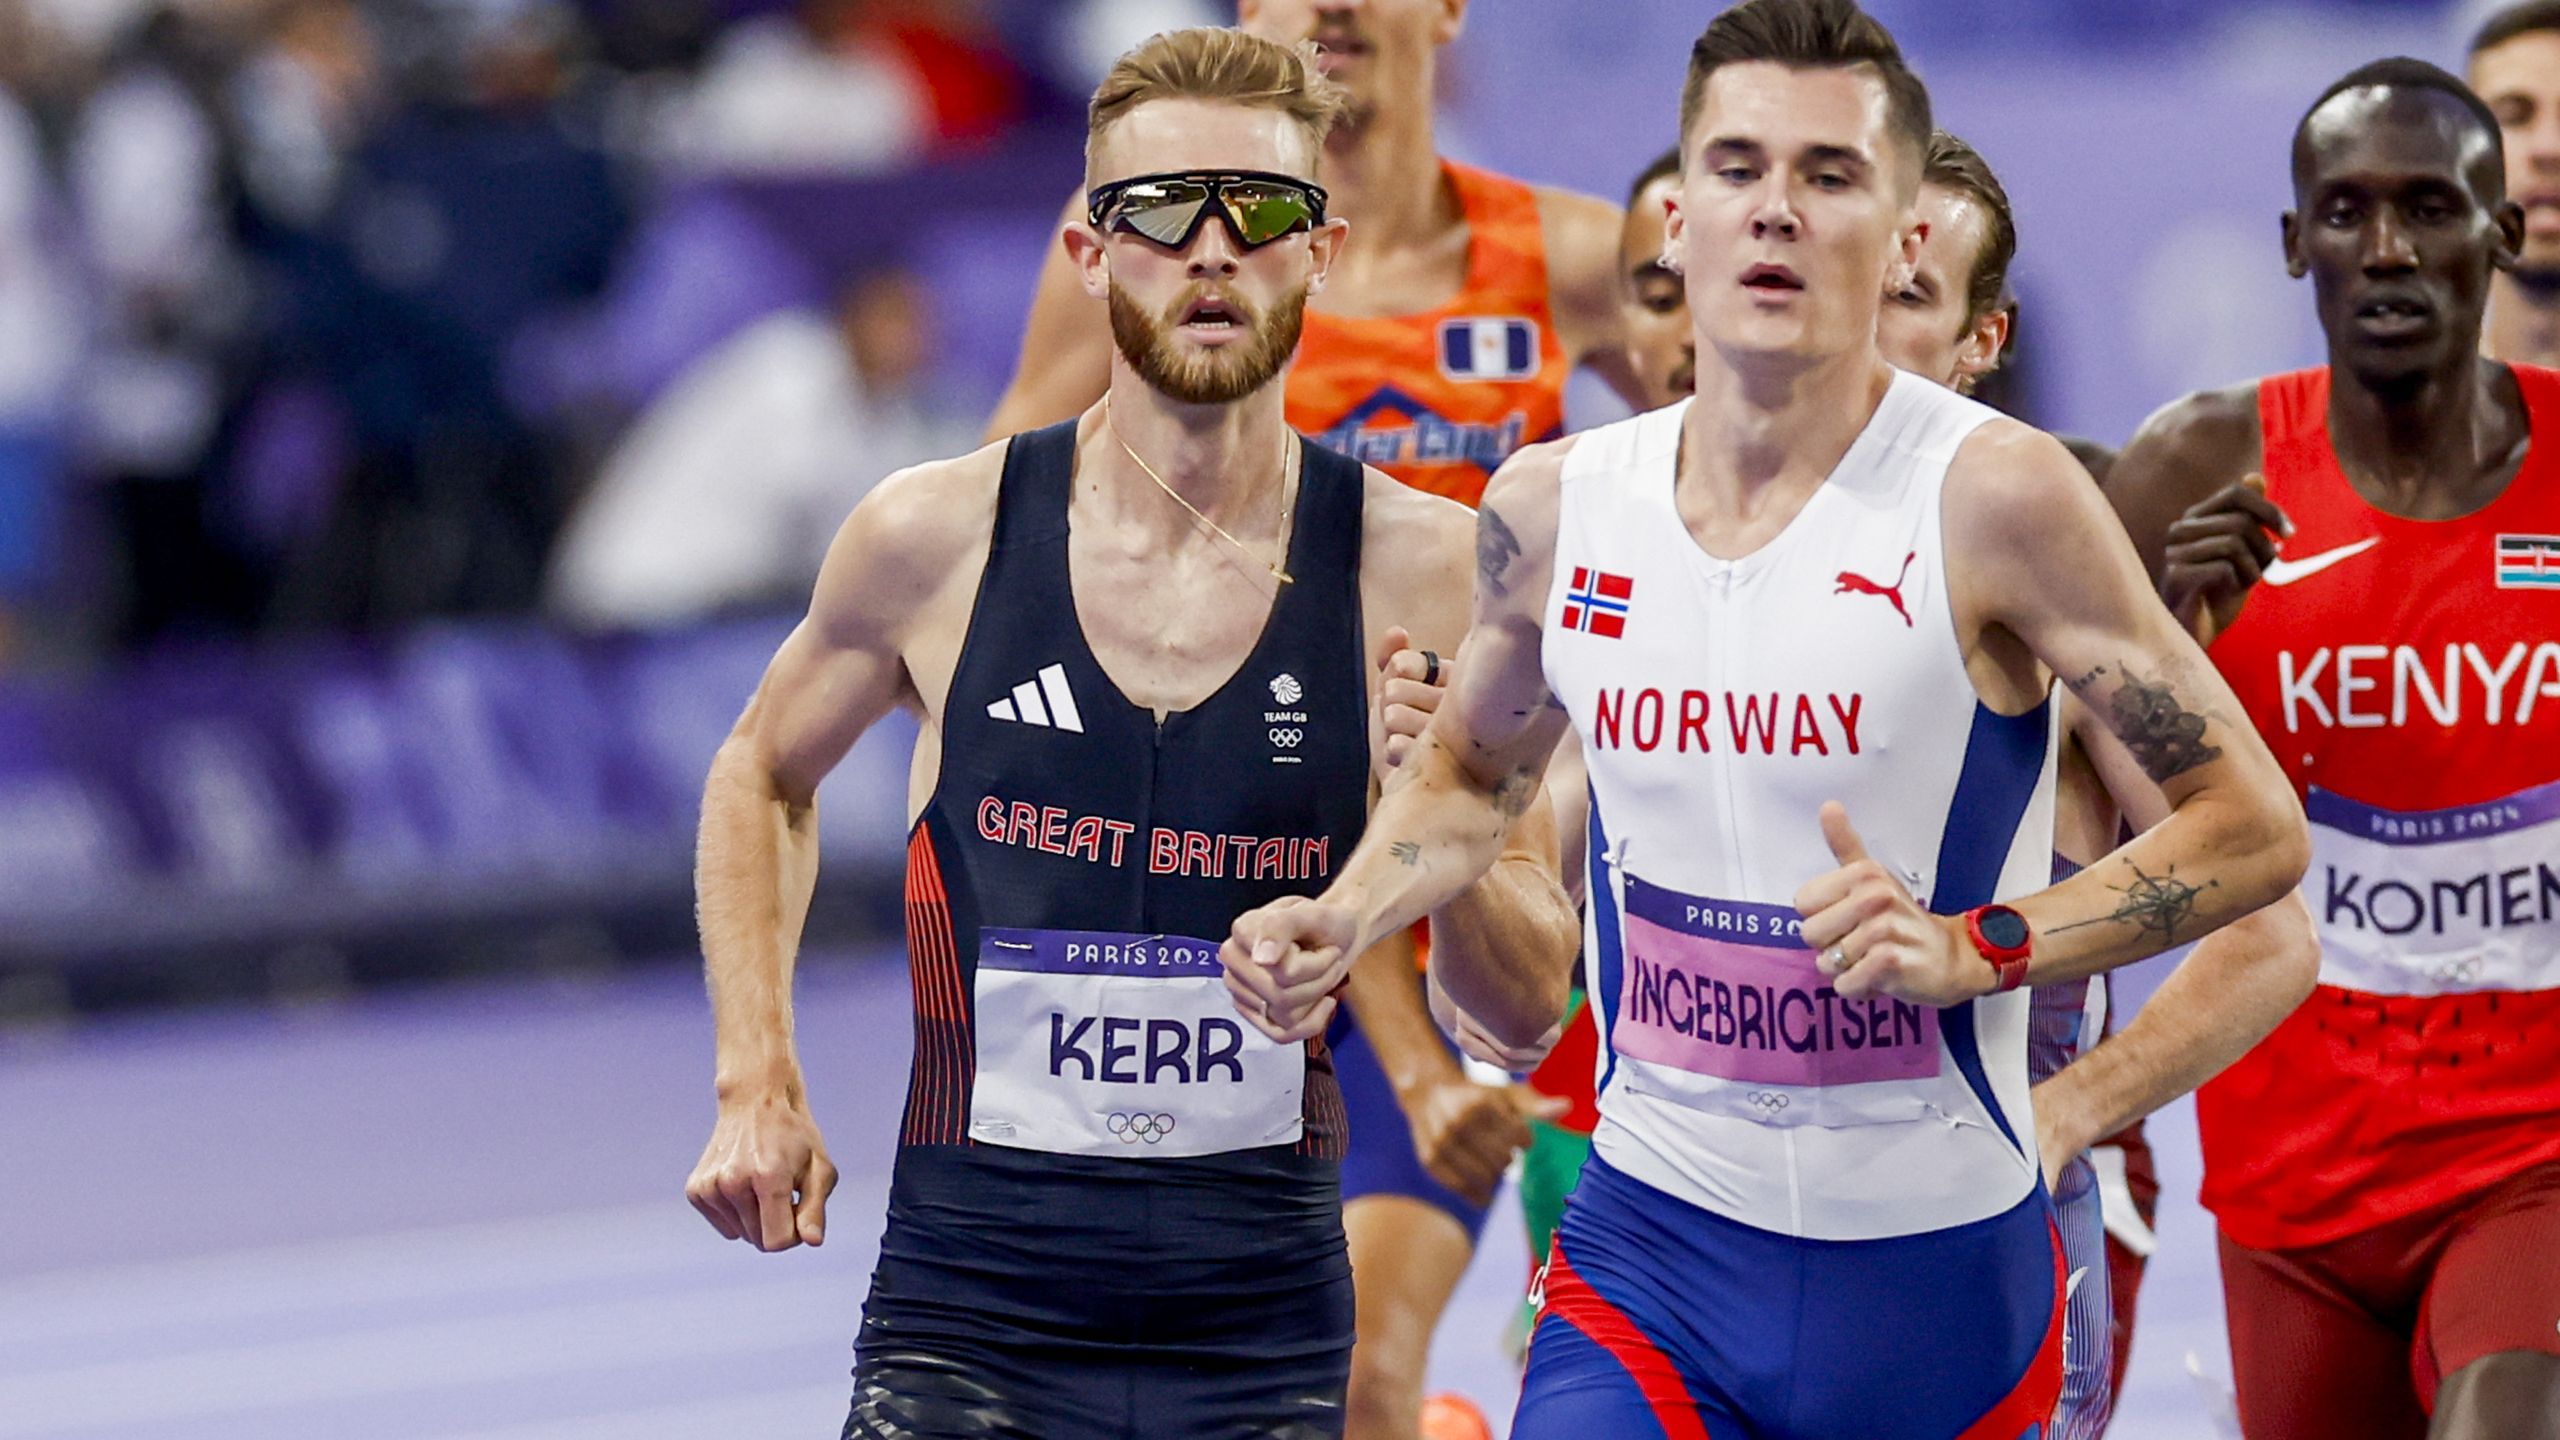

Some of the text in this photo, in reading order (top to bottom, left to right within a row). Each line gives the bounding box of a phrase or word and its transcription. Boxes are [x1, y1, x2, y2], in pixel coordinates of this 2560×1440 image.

[1263, 711, 1308, 723] TEAM GB
[1595, 687, 1861, 756] NORWAY
[2278, 642, 2560, 733] KENYA
[976, 796, 1329, 880] GREAT BRITAIN
[2371, 814, 2445, 838] PARIS
[1066, 943, 1222, 966] PARIS 202
[1685, 905, 1803, 936] PARIS 20
[1630, 955, 1923, 1054] INGEBRIGTSEN
[1049, 1012, 1244, 1084] KERR
